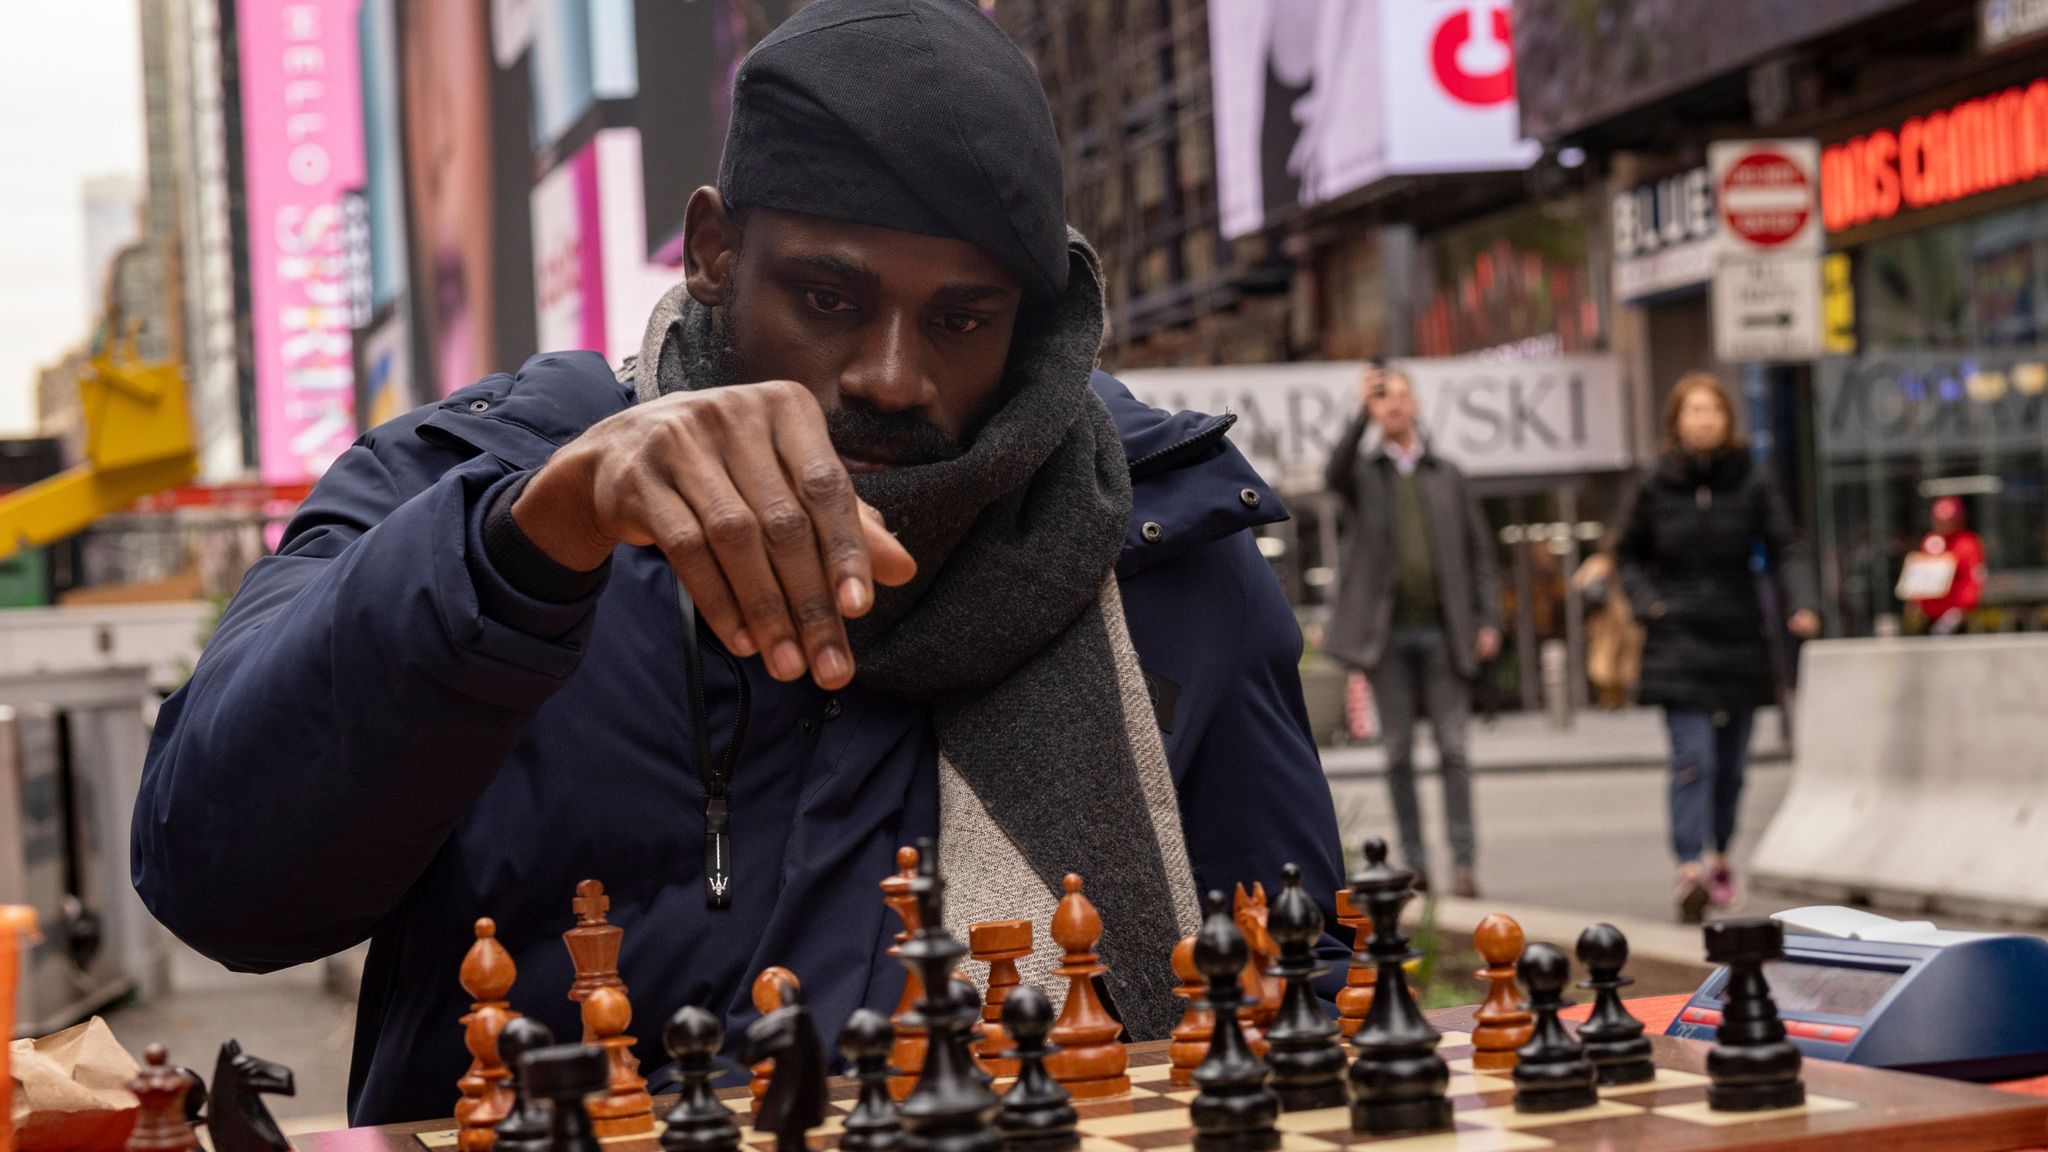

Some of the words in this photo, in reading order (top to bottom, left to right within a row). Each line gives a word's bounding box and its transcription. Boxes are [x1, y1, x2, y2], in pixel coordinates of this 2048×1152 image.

[283, 5, 330, 185] HELLO
[1616, 170, 1711, 254] BLUE
[275, 203, 354, 475] SPRIN
